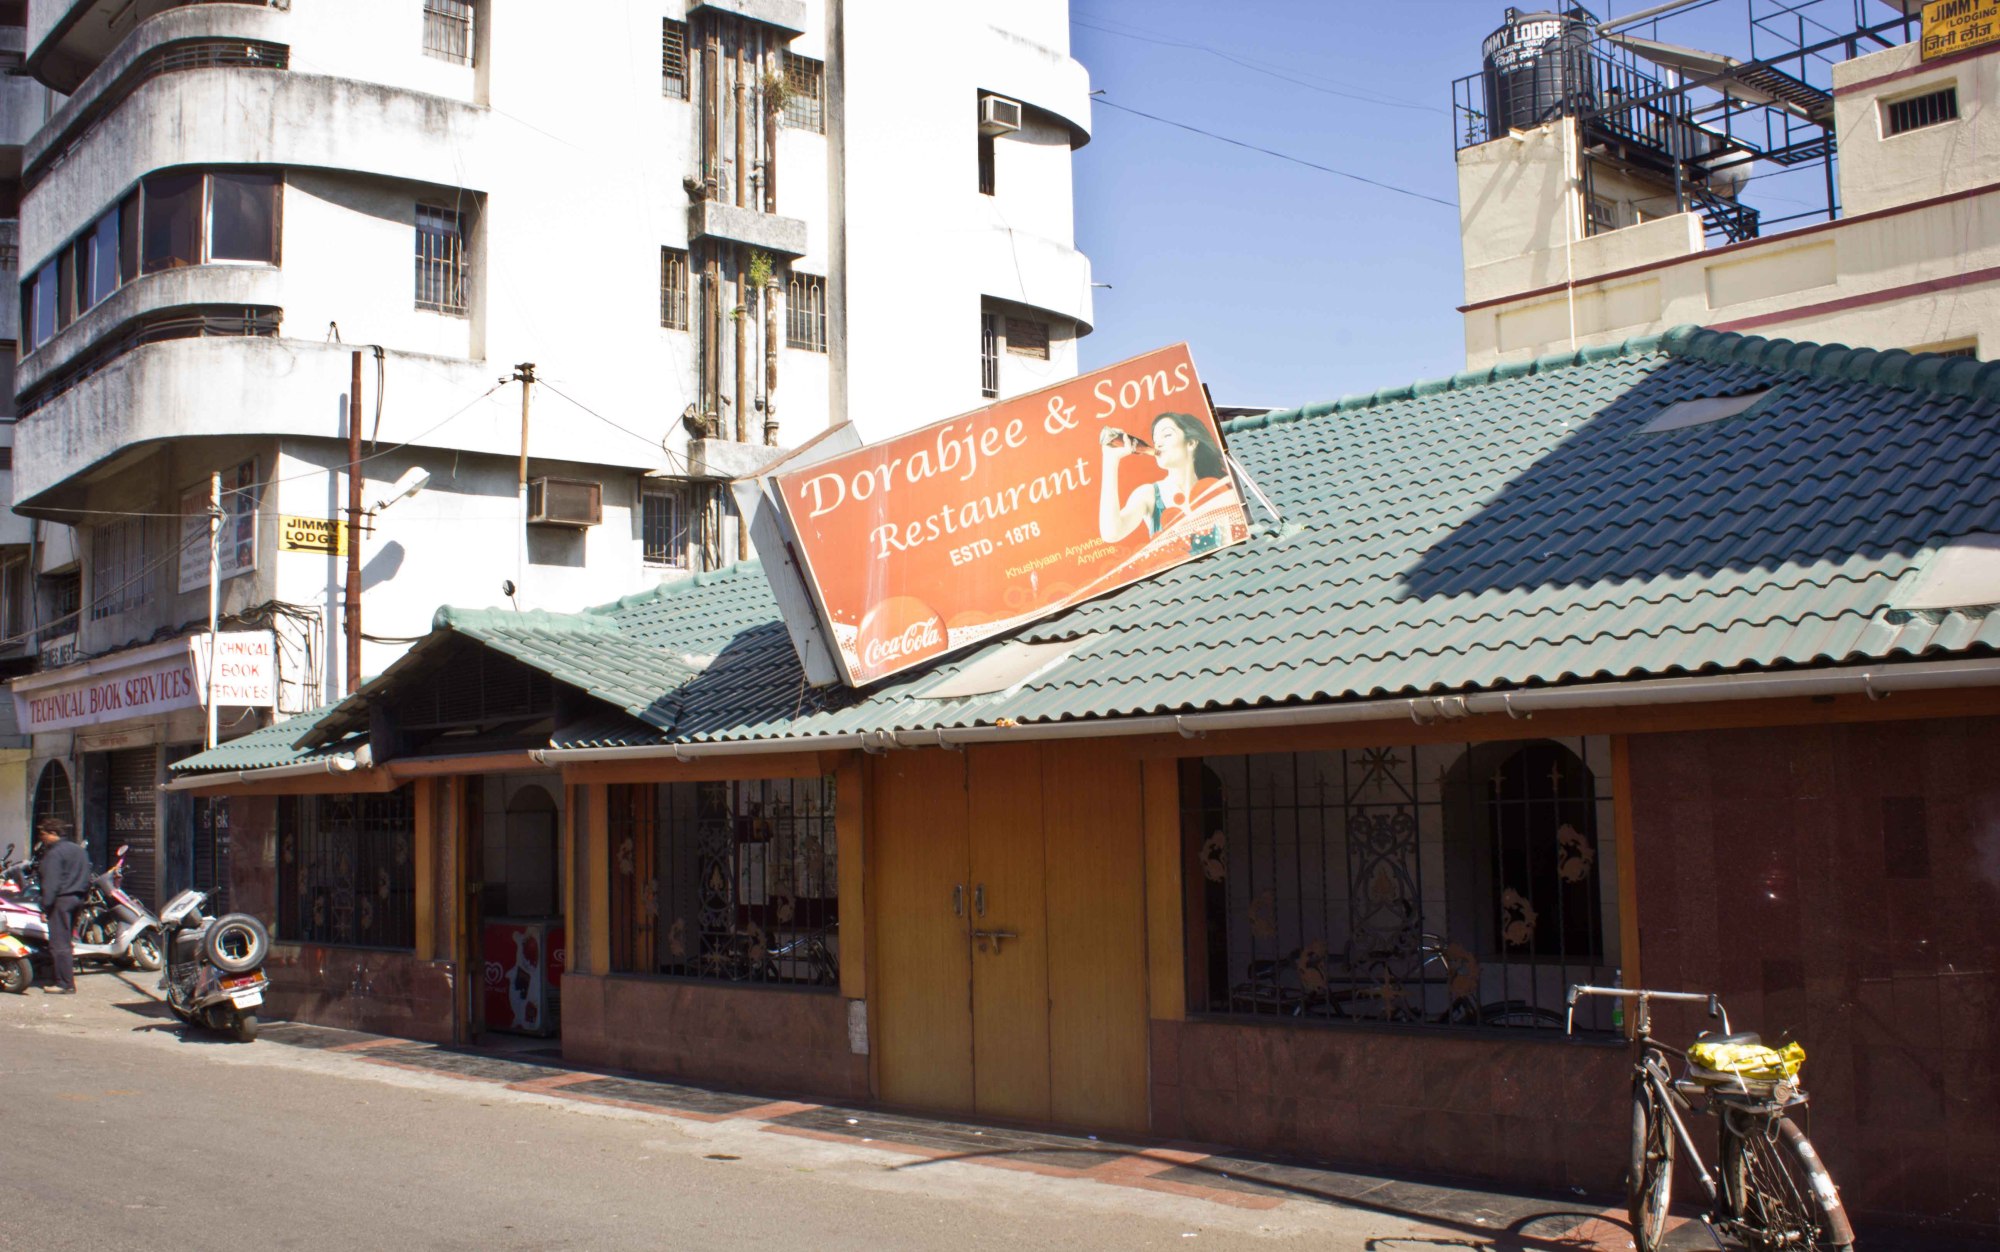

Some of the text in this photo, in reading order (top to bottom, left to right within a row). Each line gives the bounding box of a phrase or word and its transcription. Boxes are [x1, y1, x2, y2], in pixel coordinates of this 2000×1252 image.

[1930, 0, 1979, 23] JIMMY
[1514, 20, 1561, 43] LODGE
[801, 362, 1191, 518] Dorabjee & Sons
[870, 457, 1092, 560] Restaurant
[287, 519, 338, 532] JIMMY
[286, 531, 338, 545] LODGE
[949, 538, 993, 567] ESTD
[1005, 521, 1041, 546] 1878
[1005, 552, 1062, 579] Khushiyaan
[204, 641, 269, 656] TCHNICAL
[864, 615, 939, 668] Coca-Cola
[221, 663, 260, 677] BOOK
[30, 667, 192, 724] TECHNICAL BOOK SERVICES
[214, 683, 269, 699] ERVICES
